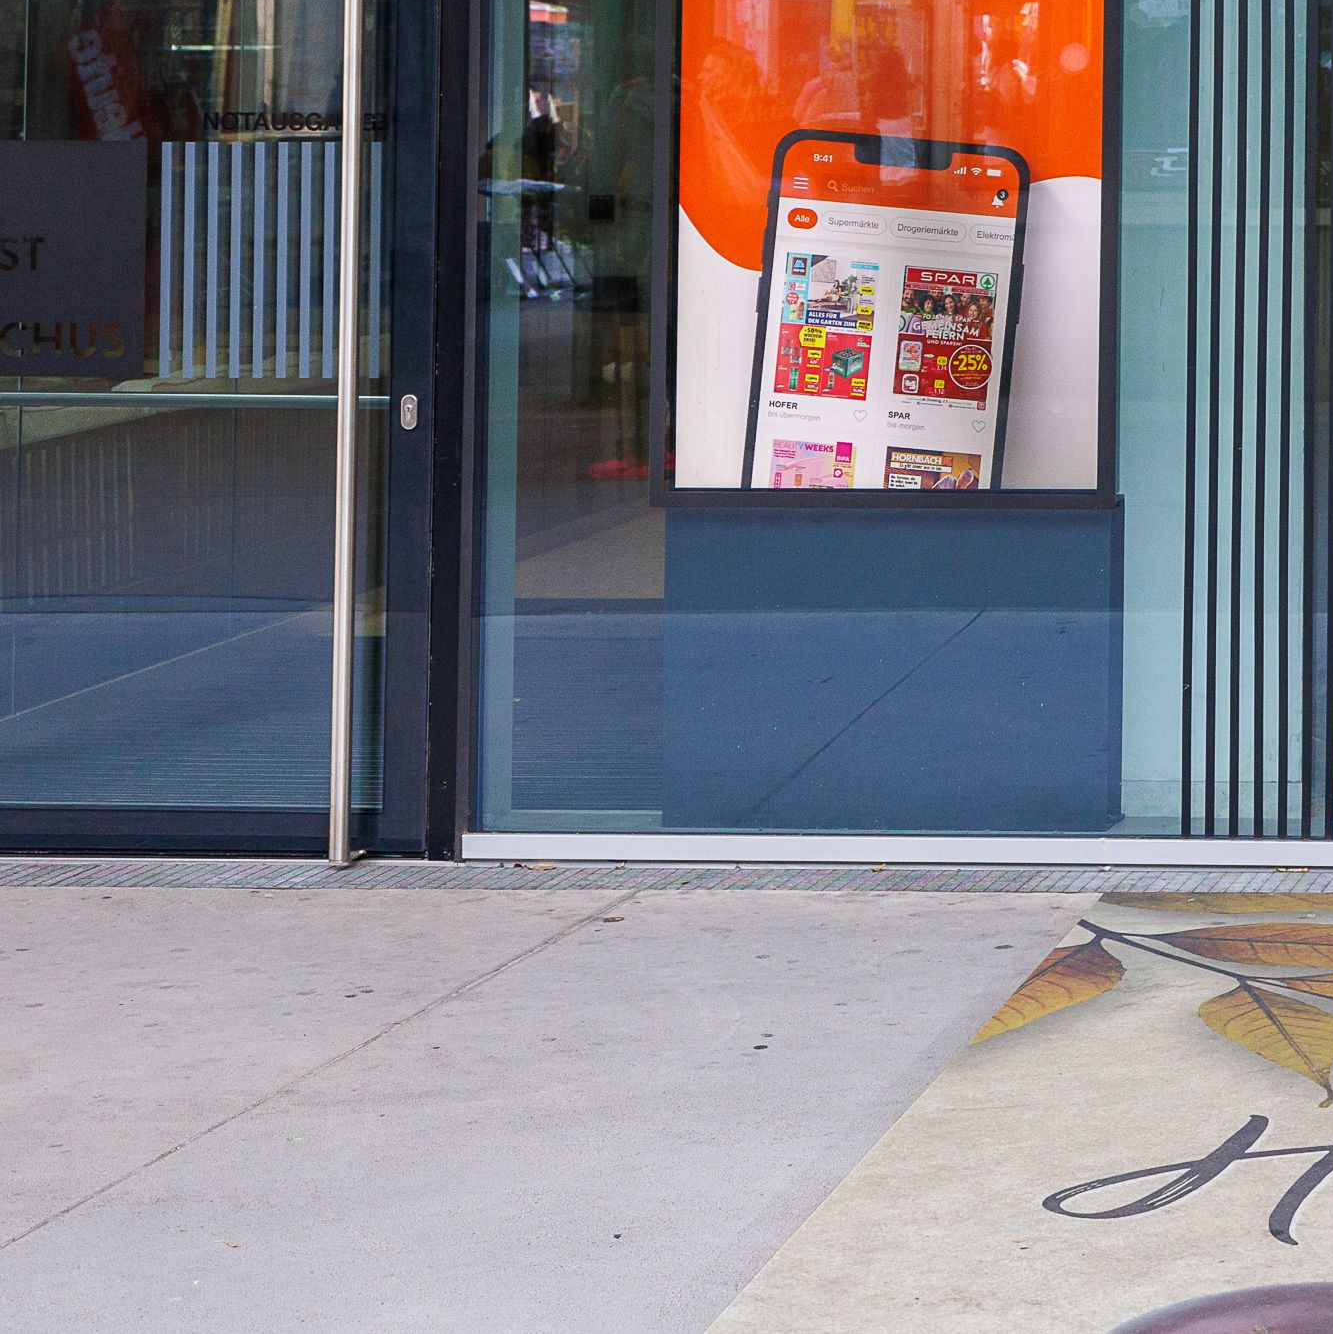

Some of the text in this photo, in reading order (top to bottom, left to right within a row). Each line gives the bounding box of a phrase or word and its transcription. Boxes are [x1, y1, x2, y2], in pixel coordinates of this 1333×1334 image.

[813, 153, 833, 163] 9:41
[794, 213, 810, 223] Alle
[828, 217, 879, 230] Supermärkte
[897, 222, 959, 238] Drogeriemärkte
[921, 272, 975, 285] SPAR
[953, 354, 988, 371] -25%
[769, 400, 798, 410] HOFER
[780, 411, 821, 422] übermorgen
[888, 411, 911, 420] SPAR
[899, 423, 925, 433] morgen
[805, 444, 834, 452] WEEKS
[892, 452, 942, 465] HORNBACH
